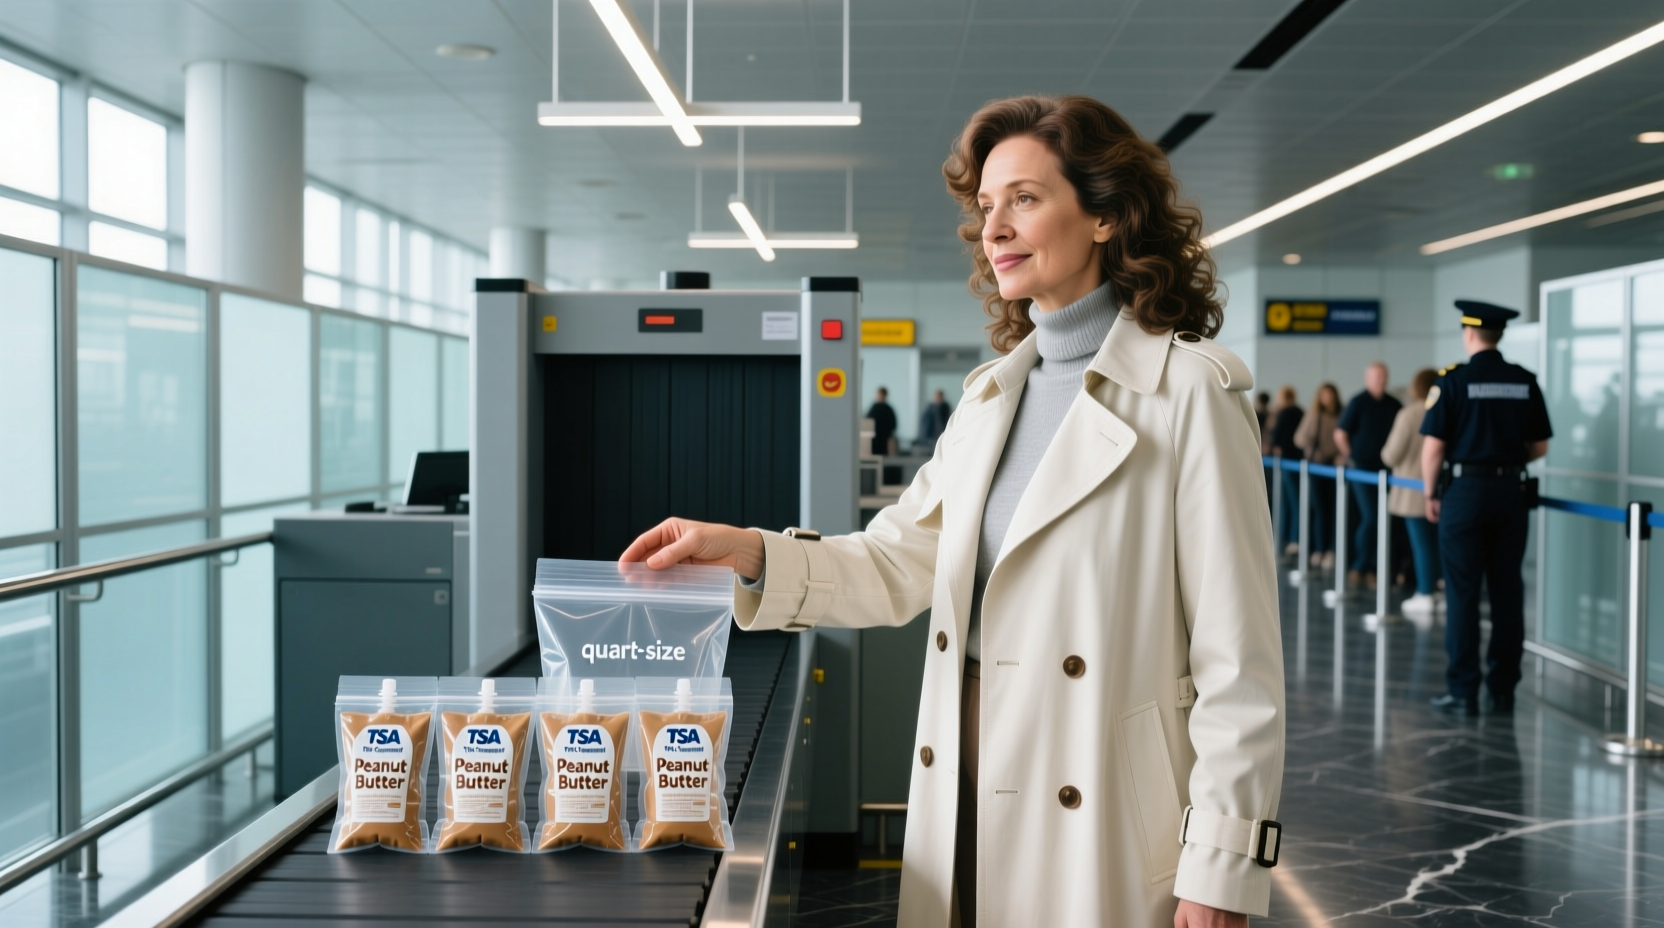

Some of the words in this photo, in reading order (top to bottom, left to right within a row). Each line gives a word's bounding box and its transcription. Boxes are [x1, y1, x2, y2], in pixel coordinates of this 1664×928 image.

[581, 640, 686, 664] quart-size
[367, 729, 401, 745] TSA
[467, 729, 501, 745] TSA
[567, 729, 602, 745] TSA
[666, 728, 700, 744] TSA
[355, 758, 408, 774] Peanut
[455, 758, 509, 774] Peanut
[557, 758, 610, 774] Peanut
[656, 757, 709, 773] Peanut
[355, 775, 405, 789] Butter
[456, 774, 506, 790] Butter
[558, 775, 608, 790] Butter
[658, 774, 708, 789] Butter
